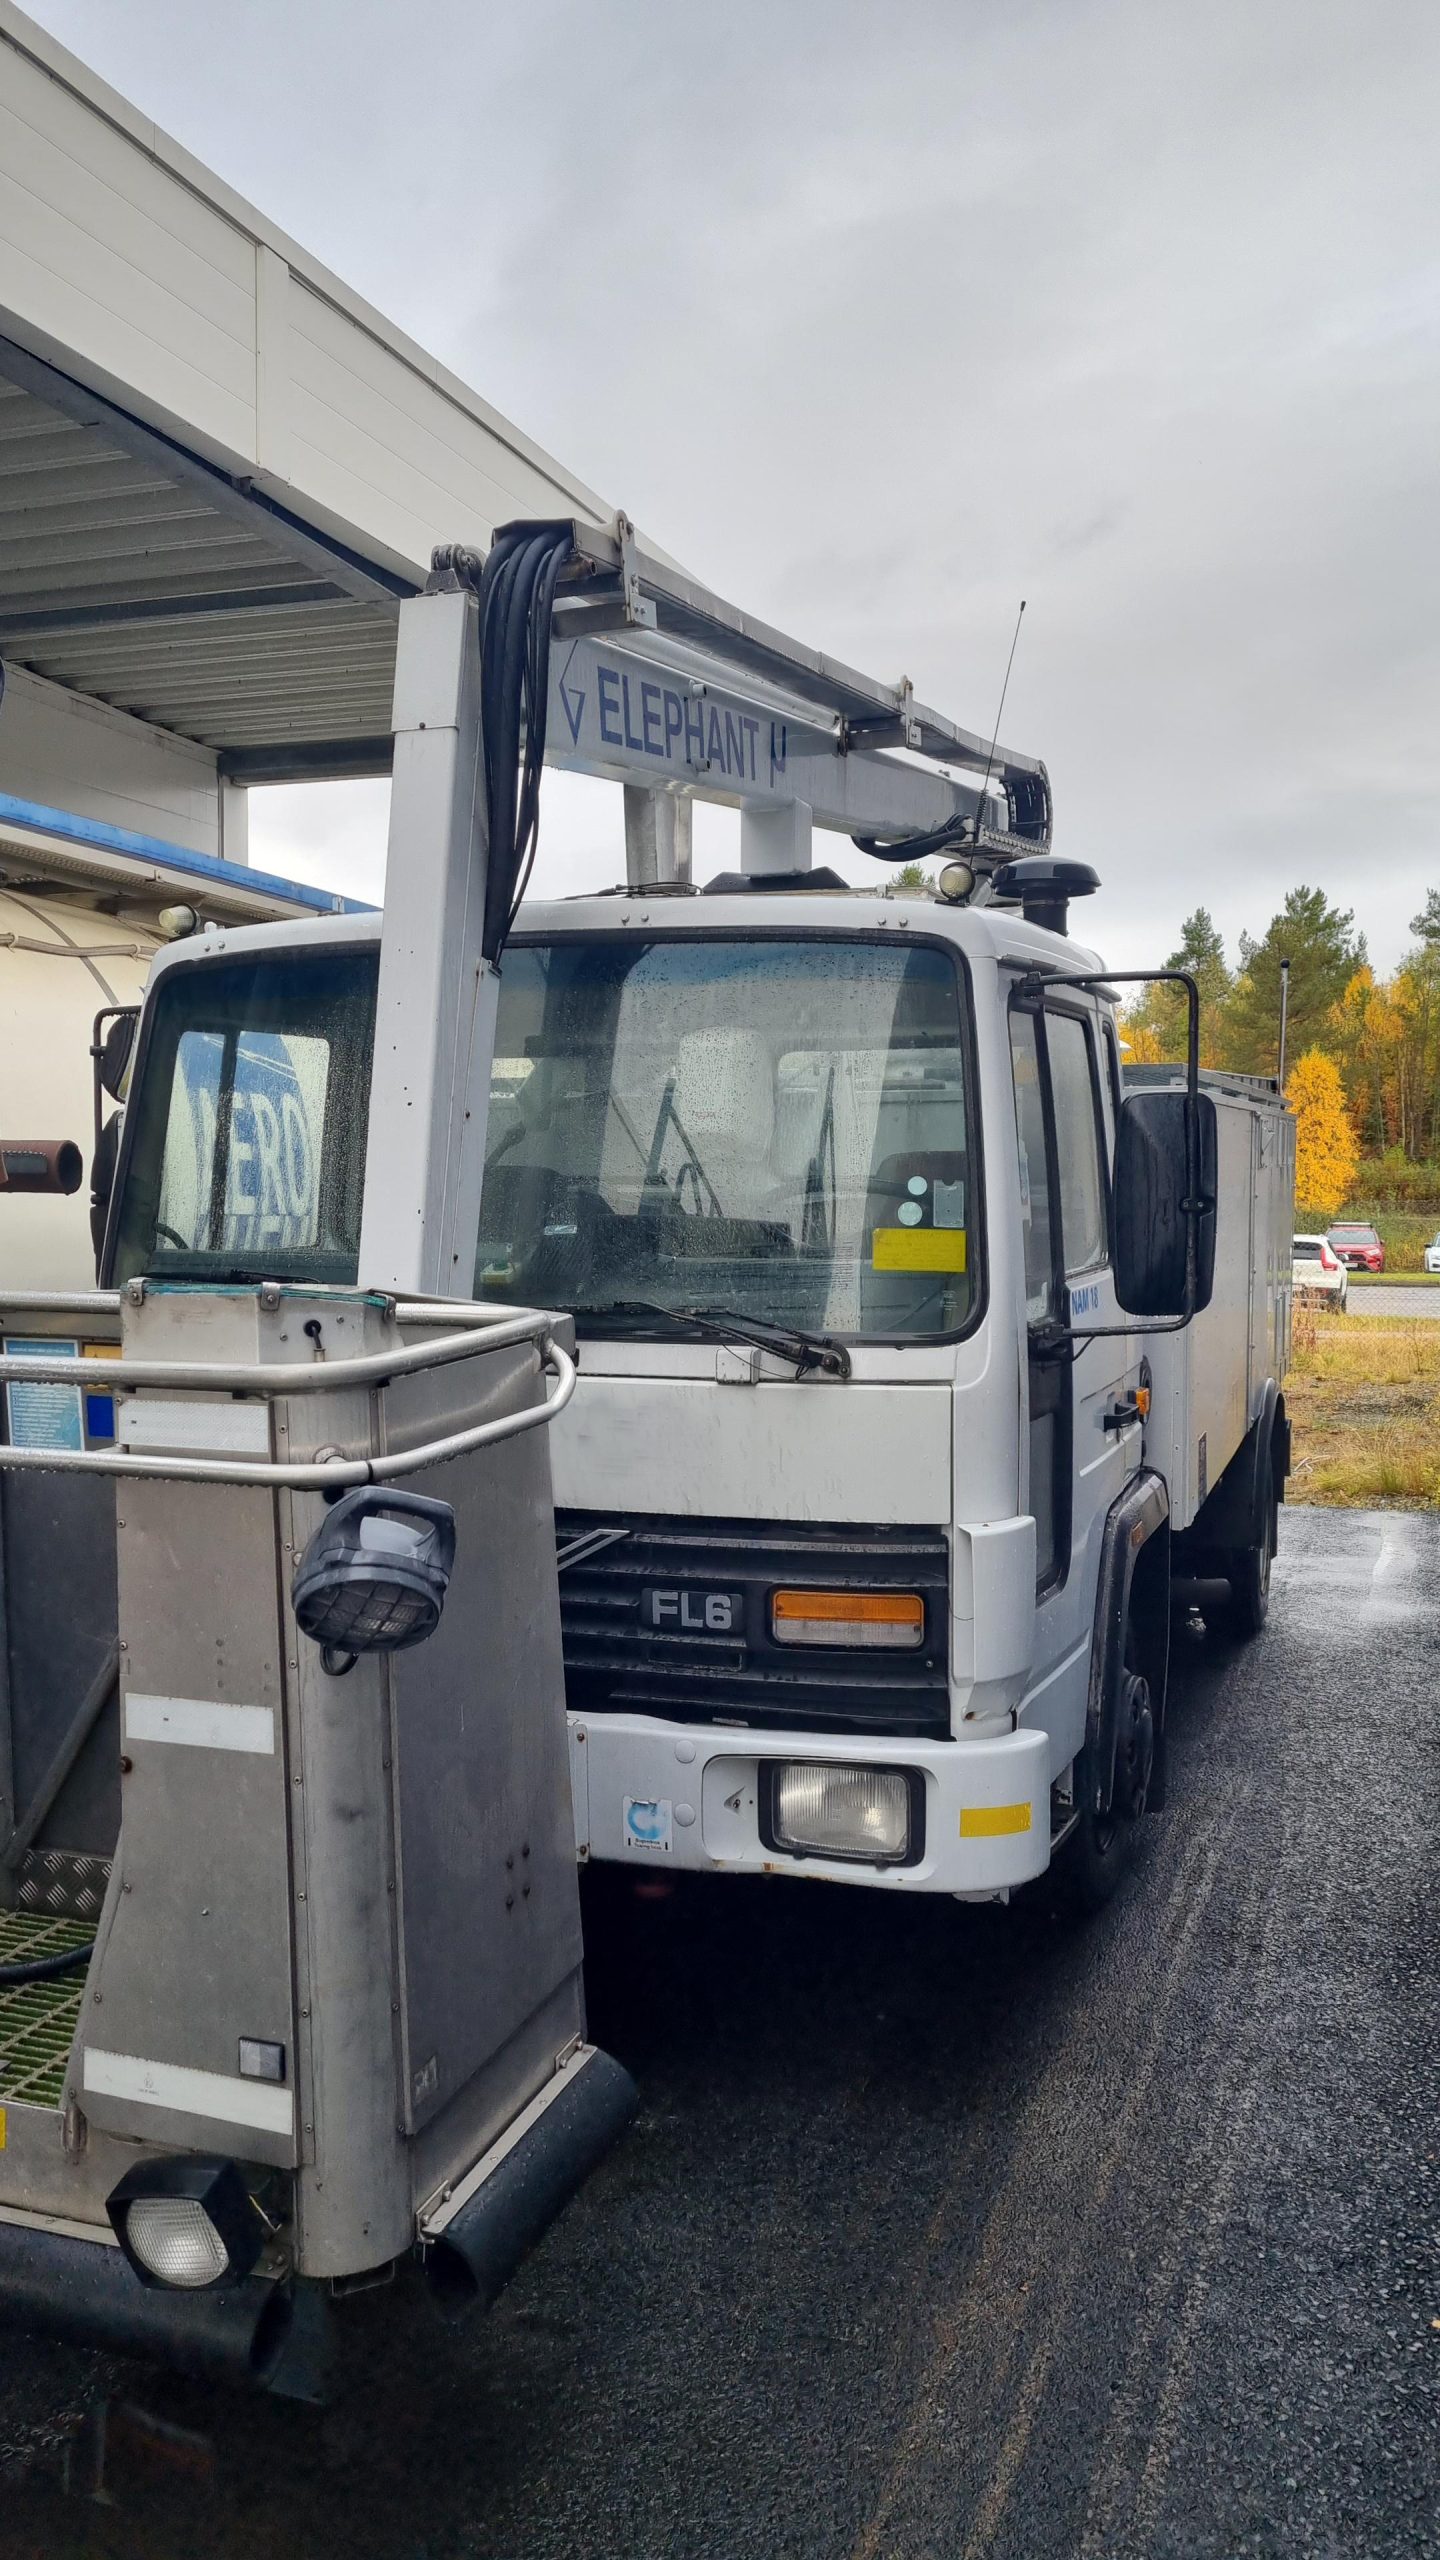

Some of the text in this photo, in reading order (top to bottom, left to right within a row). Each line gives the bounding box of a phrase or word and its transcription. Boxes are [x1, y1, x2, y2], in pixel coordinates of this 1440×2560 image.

[597, 666, 759, 781] ELEPHANT
[1071, 1288, 1090, 1316] NAM
[652, 1590, 732, 1630] FL6
